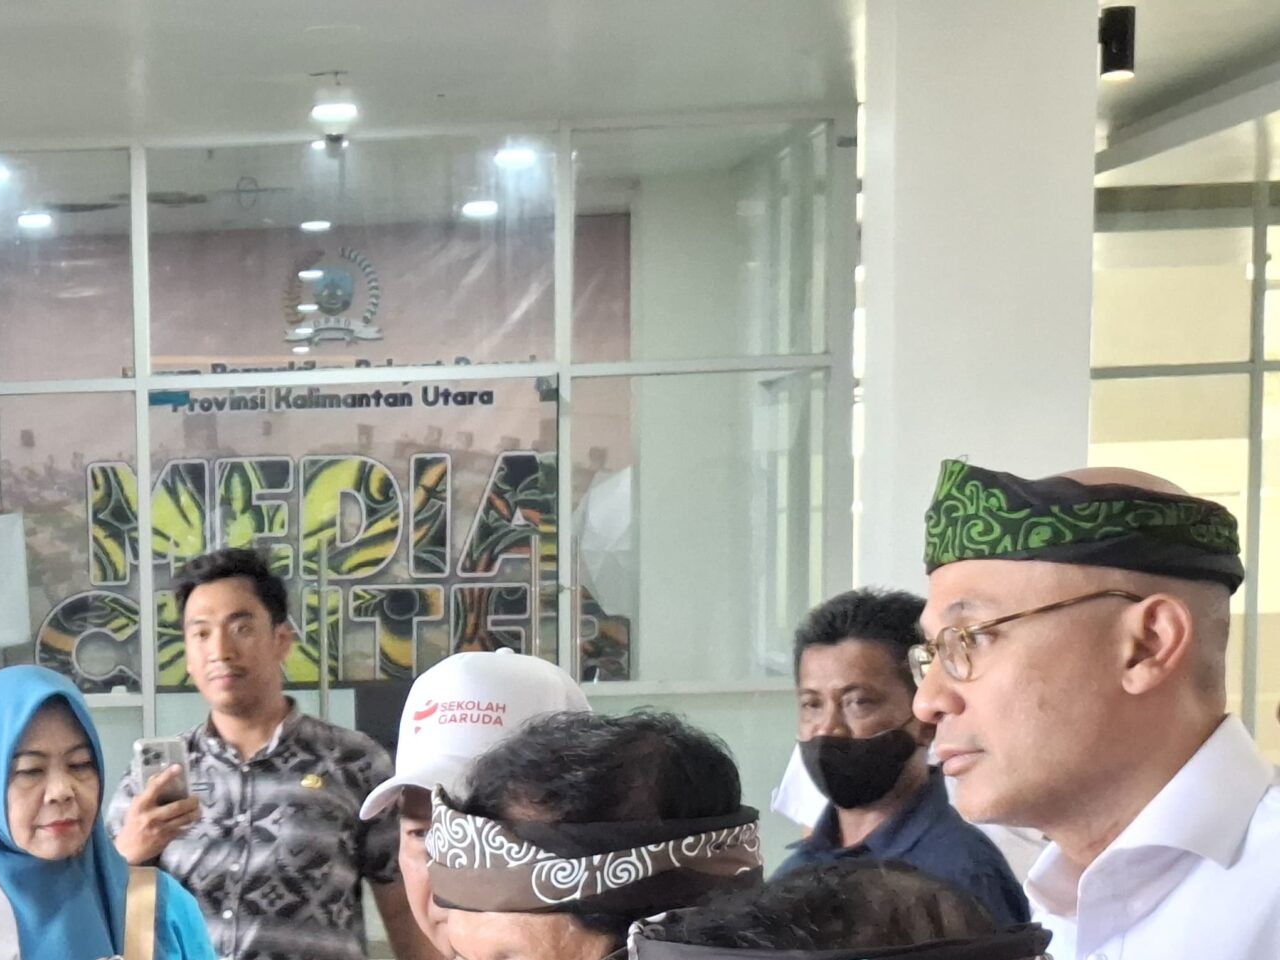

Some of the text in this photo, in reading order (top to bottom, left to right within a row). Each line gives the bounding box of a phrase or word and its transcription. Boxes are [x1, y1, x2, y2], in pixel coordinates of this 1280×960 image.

[274, 385, 413, 411] Kalimantan
[421, 384, 495, 407] Utara
[86, 452, 560, 586] MEDIA
[440, 700, 506, 714] SEKOLAH
[438, 713, 504, 727] GARUDA
